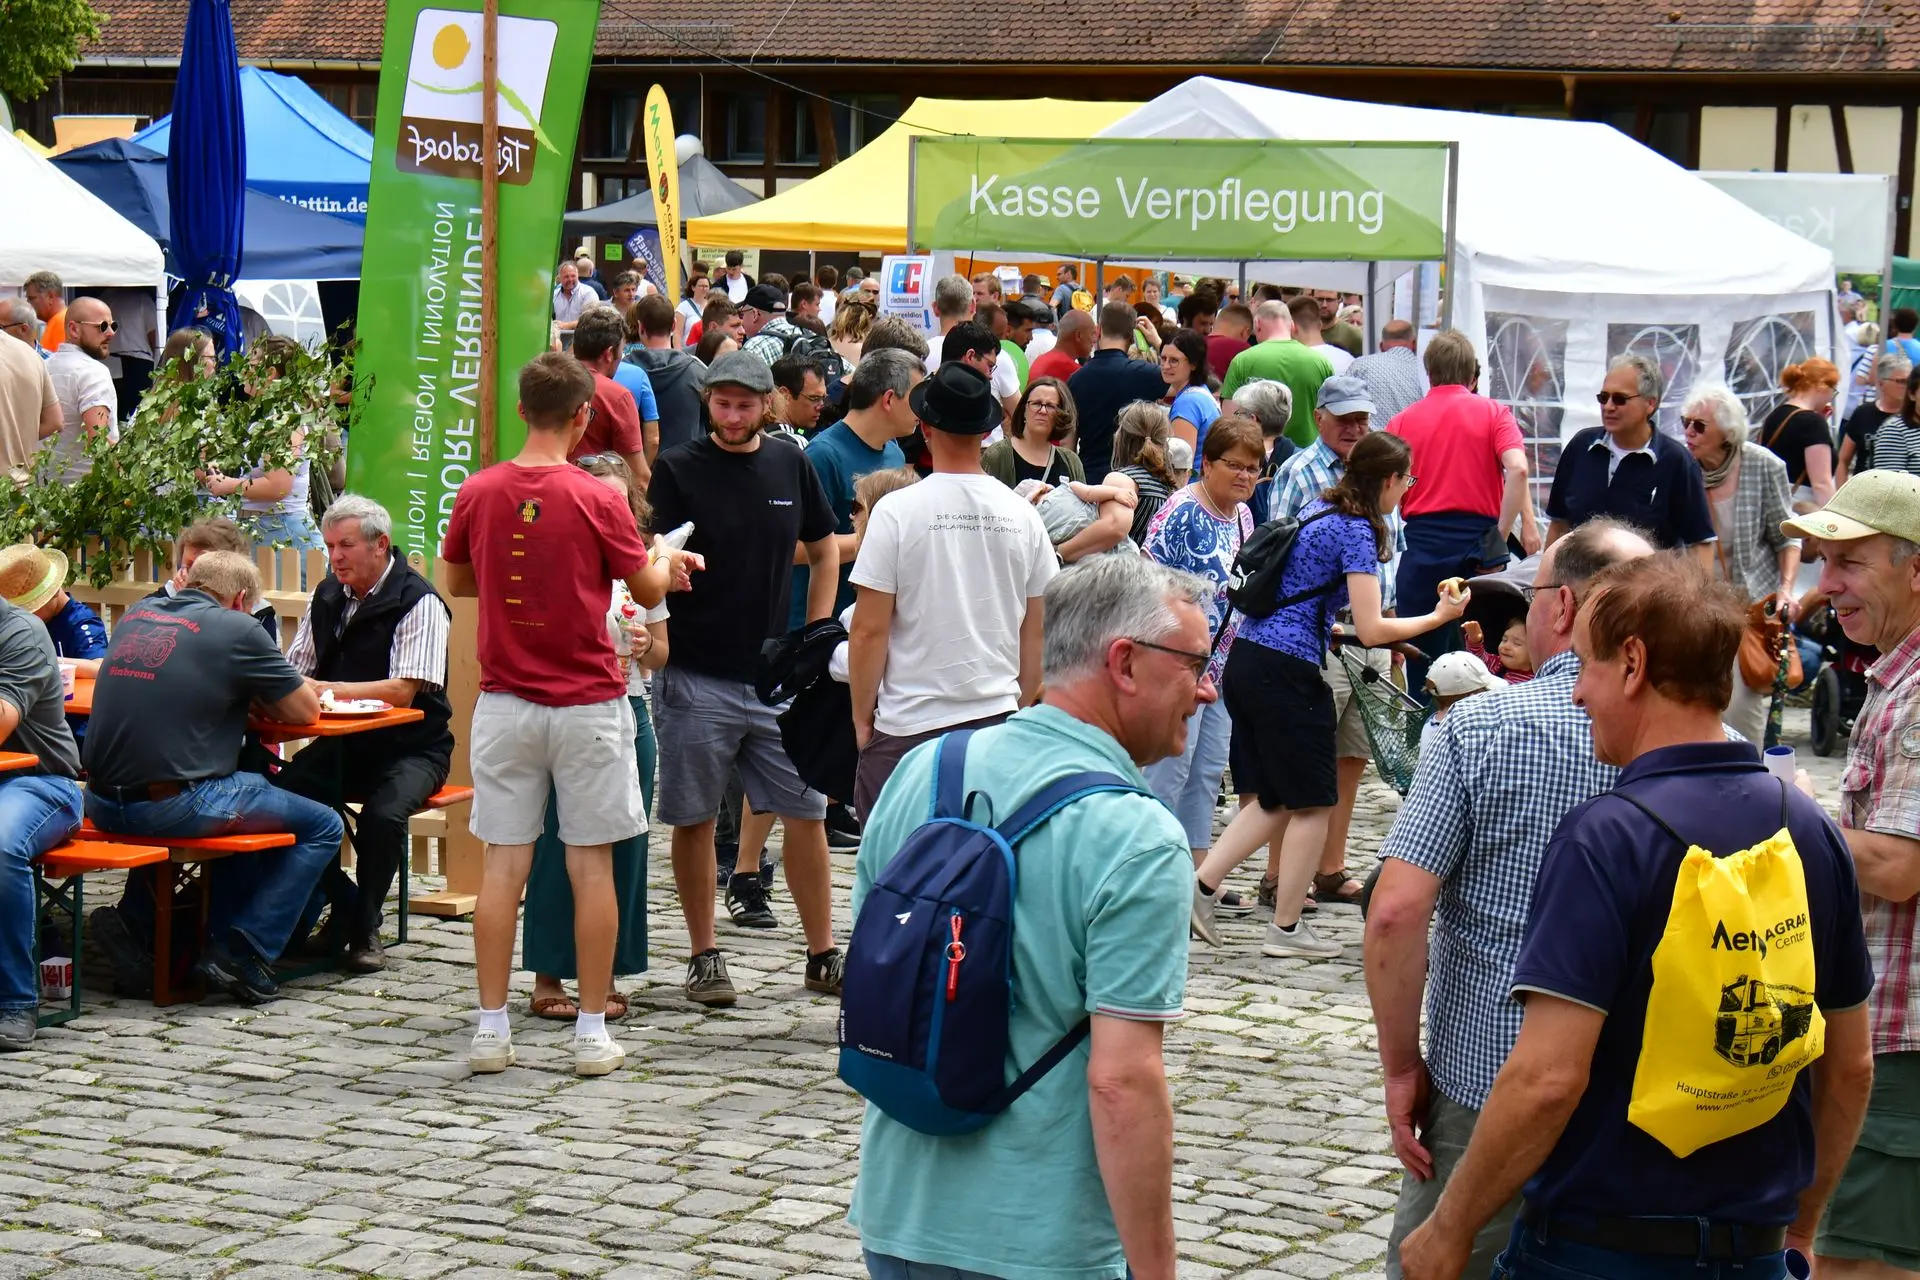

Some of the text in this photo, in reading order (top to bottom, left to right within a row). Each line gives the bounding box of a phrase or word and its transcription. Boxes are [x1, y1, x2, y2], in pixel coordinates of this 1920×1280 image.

[969, 174, 1384, 234] Kasse Verpflegung
[666, 203, 676, 255] AGRAR
[858, 1044, 893, 1058] Quechua
[1676, 1081, 1739, 1100] Hauptstraße
